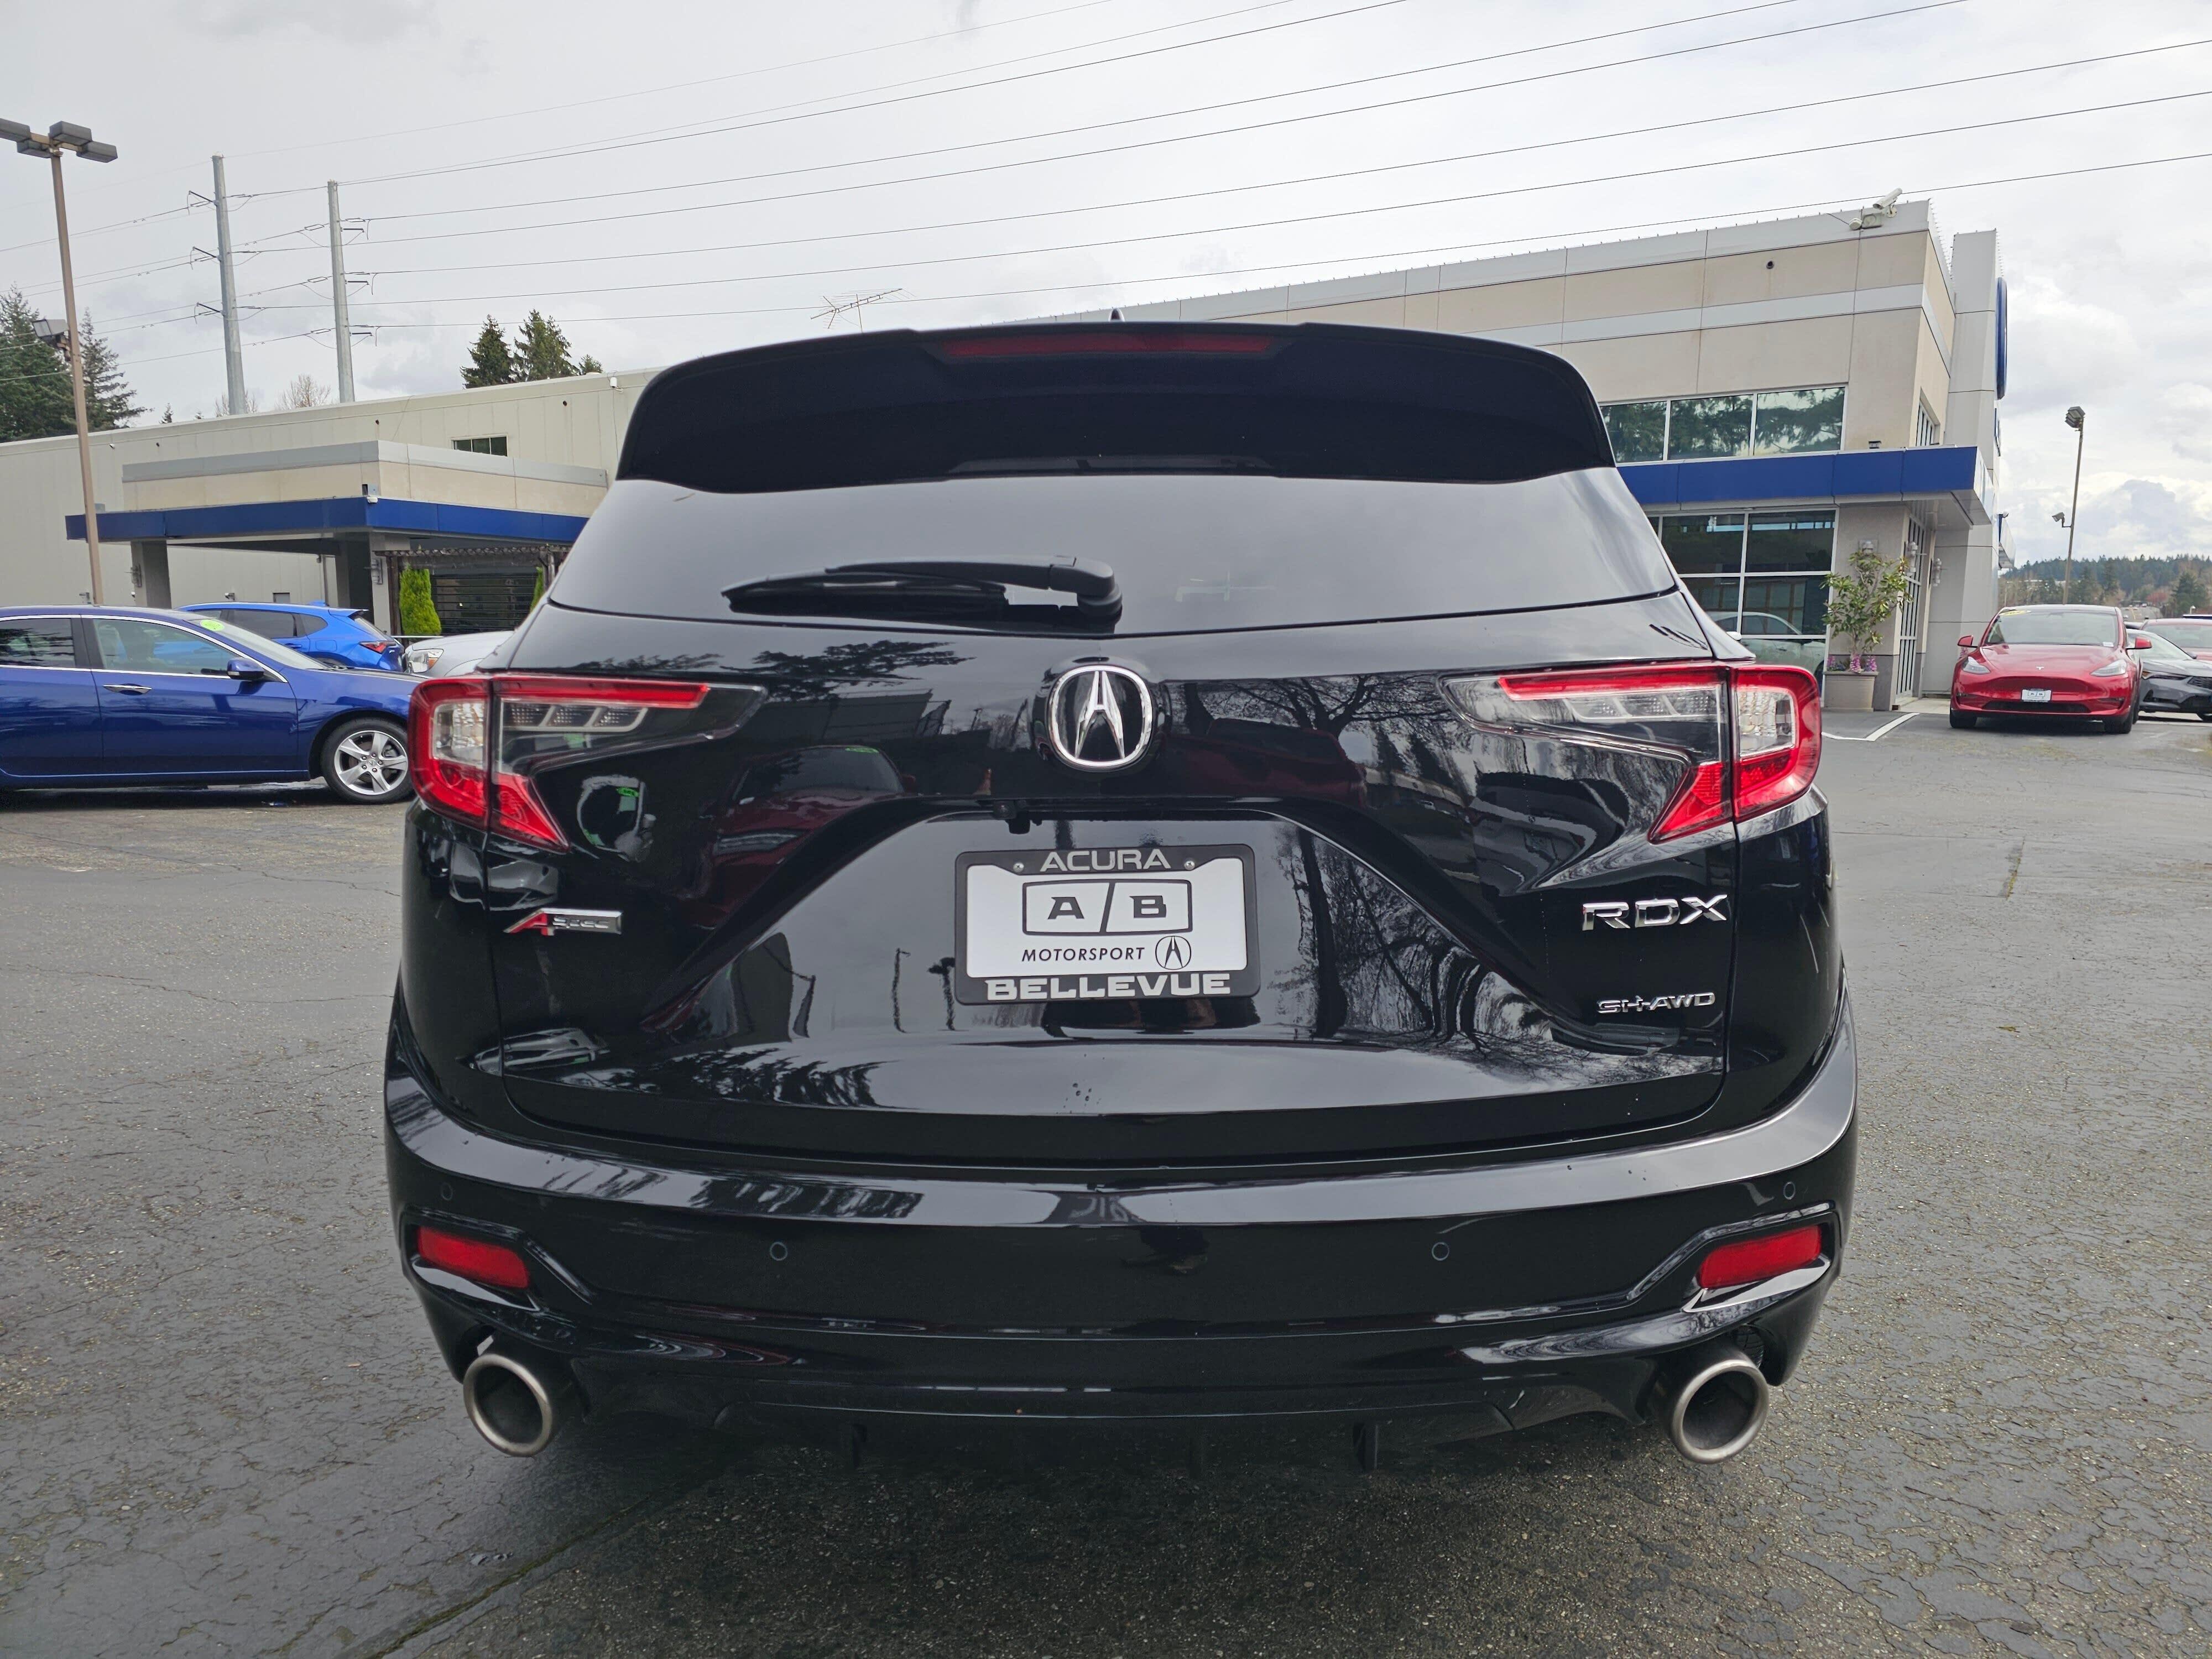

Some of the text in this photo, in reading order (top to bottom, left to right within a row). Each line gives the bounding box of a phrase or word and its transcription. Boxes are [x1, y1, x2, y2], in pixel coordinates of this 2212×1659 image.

[1040, 849, 1171, 872] ACURA
[1582, 894, 1728, 931] RDX
[1021, 947, 1145, 962] MOTORSPORT
[985, 973, 1231, 1000] BELLEVUE
[1597, 992, 1715, 1014] SH-AWD
